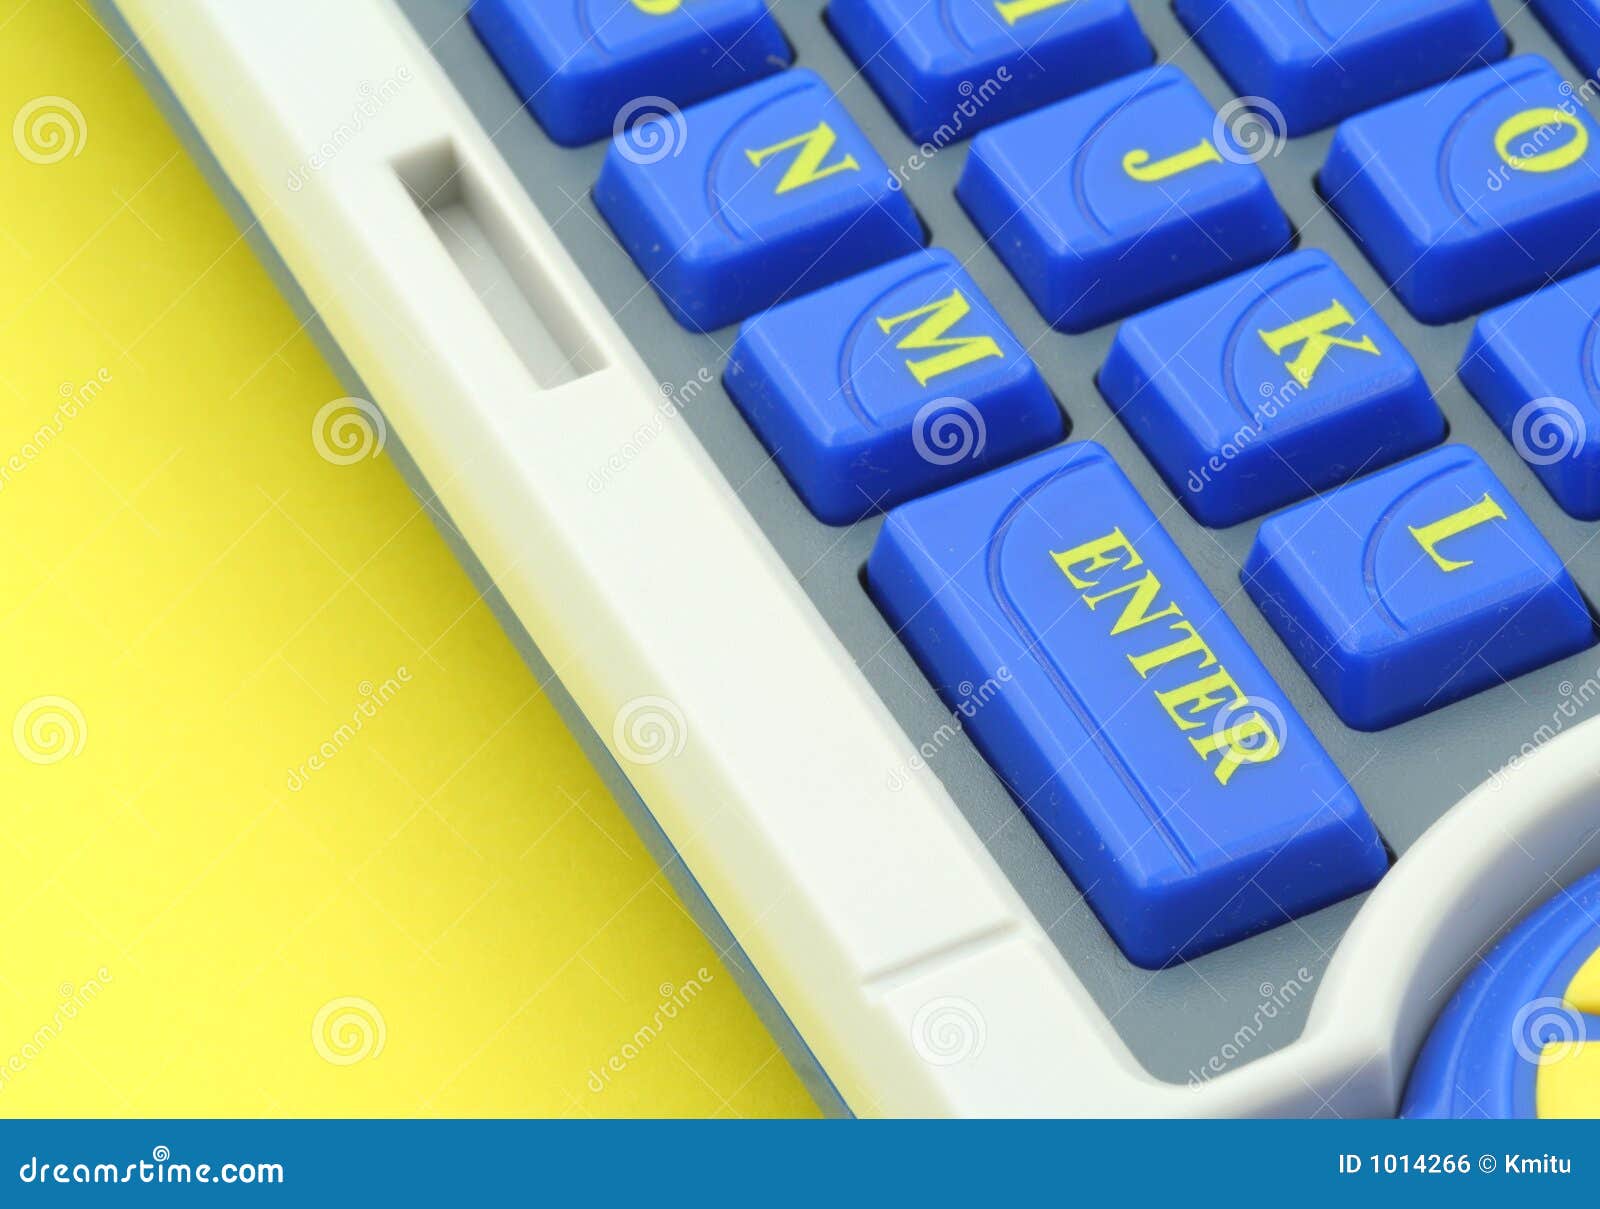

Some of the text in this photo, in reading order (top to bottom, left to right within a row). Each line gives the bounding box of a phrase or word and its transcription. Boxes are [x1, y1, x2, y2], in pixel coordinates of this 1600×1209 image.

[745, 121, 859, 194] N
[1122, 139, 1223, 182] J
[1494, 108, 1588, 172] O
[876, 289, 1003, 387] M
[1257, 299, 1381, 389] K
[1408, 493, 1506, 572] L
[1049, 527, 1279, 785] ENTER
